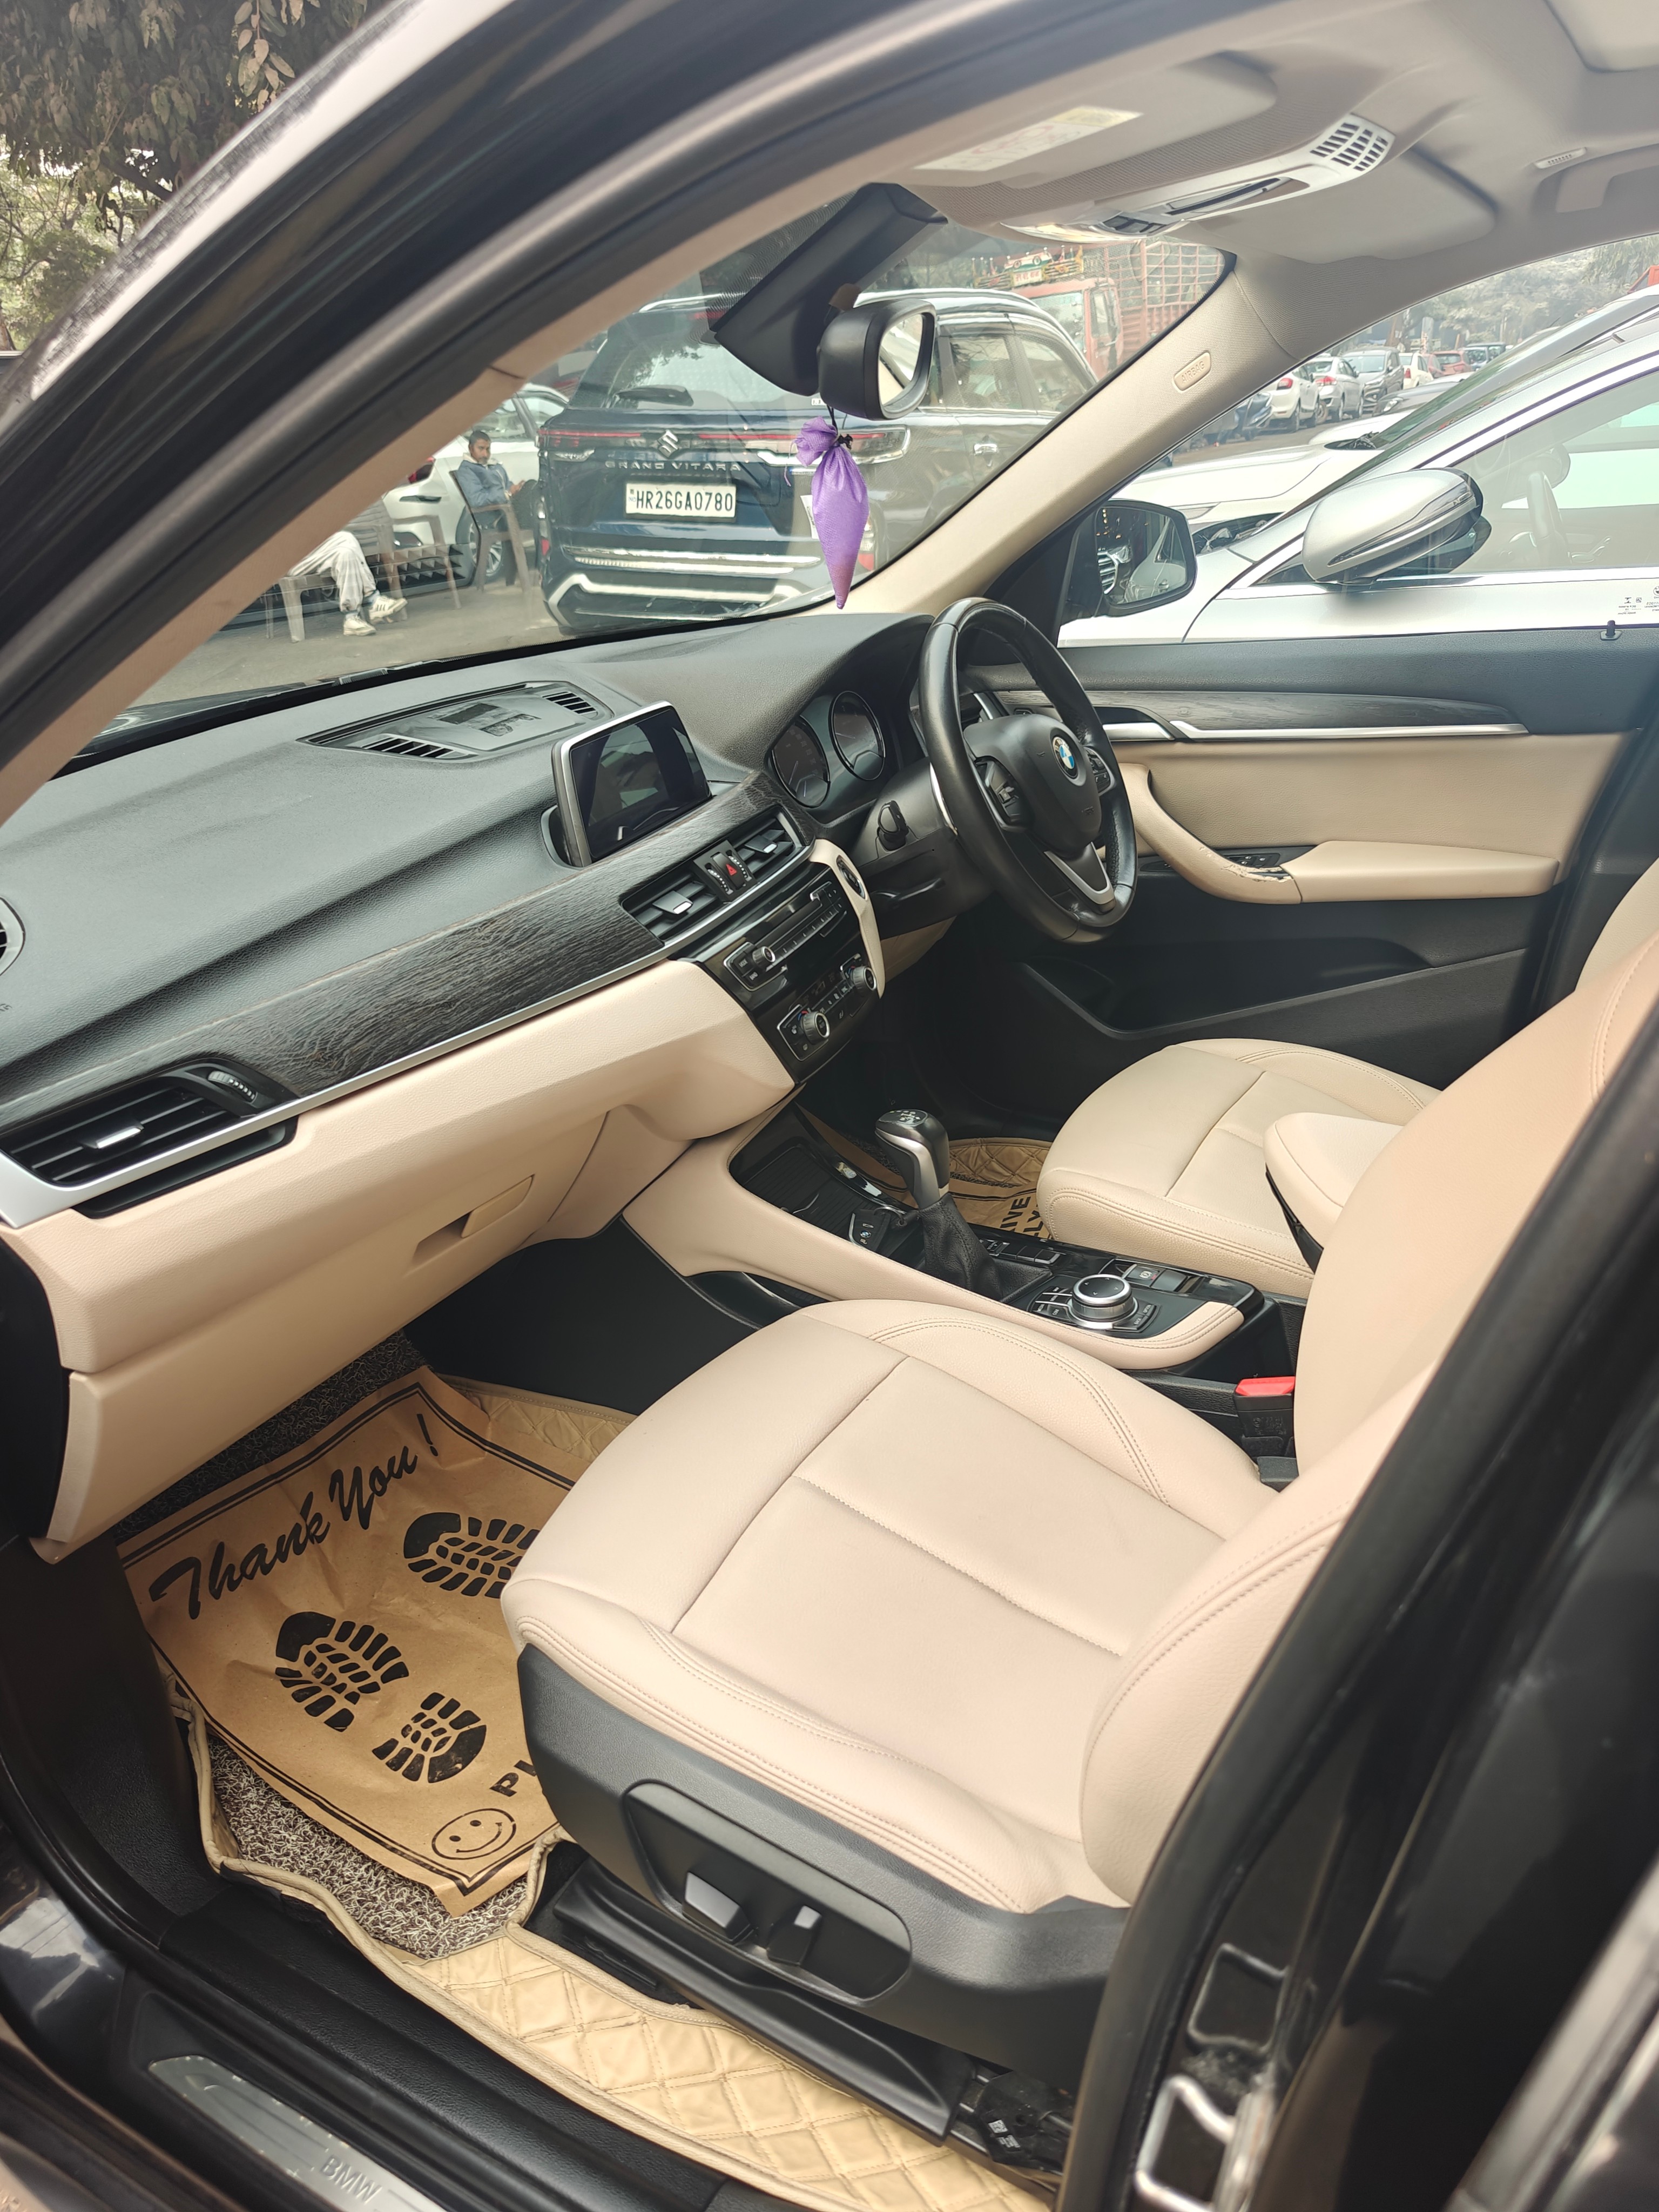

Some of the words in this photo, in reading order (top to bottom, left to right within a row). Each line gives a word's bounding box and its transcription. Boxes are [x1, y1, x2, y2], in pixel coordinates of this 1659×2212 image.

[1181, 361, 1205, 383] AIRBAG
[605, 461, 665, 470] GRAND
[671, 462, 741, 471] VITARA
[636, 490, 733, 512] HR26GA0780
[1000, 1196, 1031, 1232] IVE
[149, 1491, 331, 1620] Thank
[320, 2155, 383, 2206] BMW
